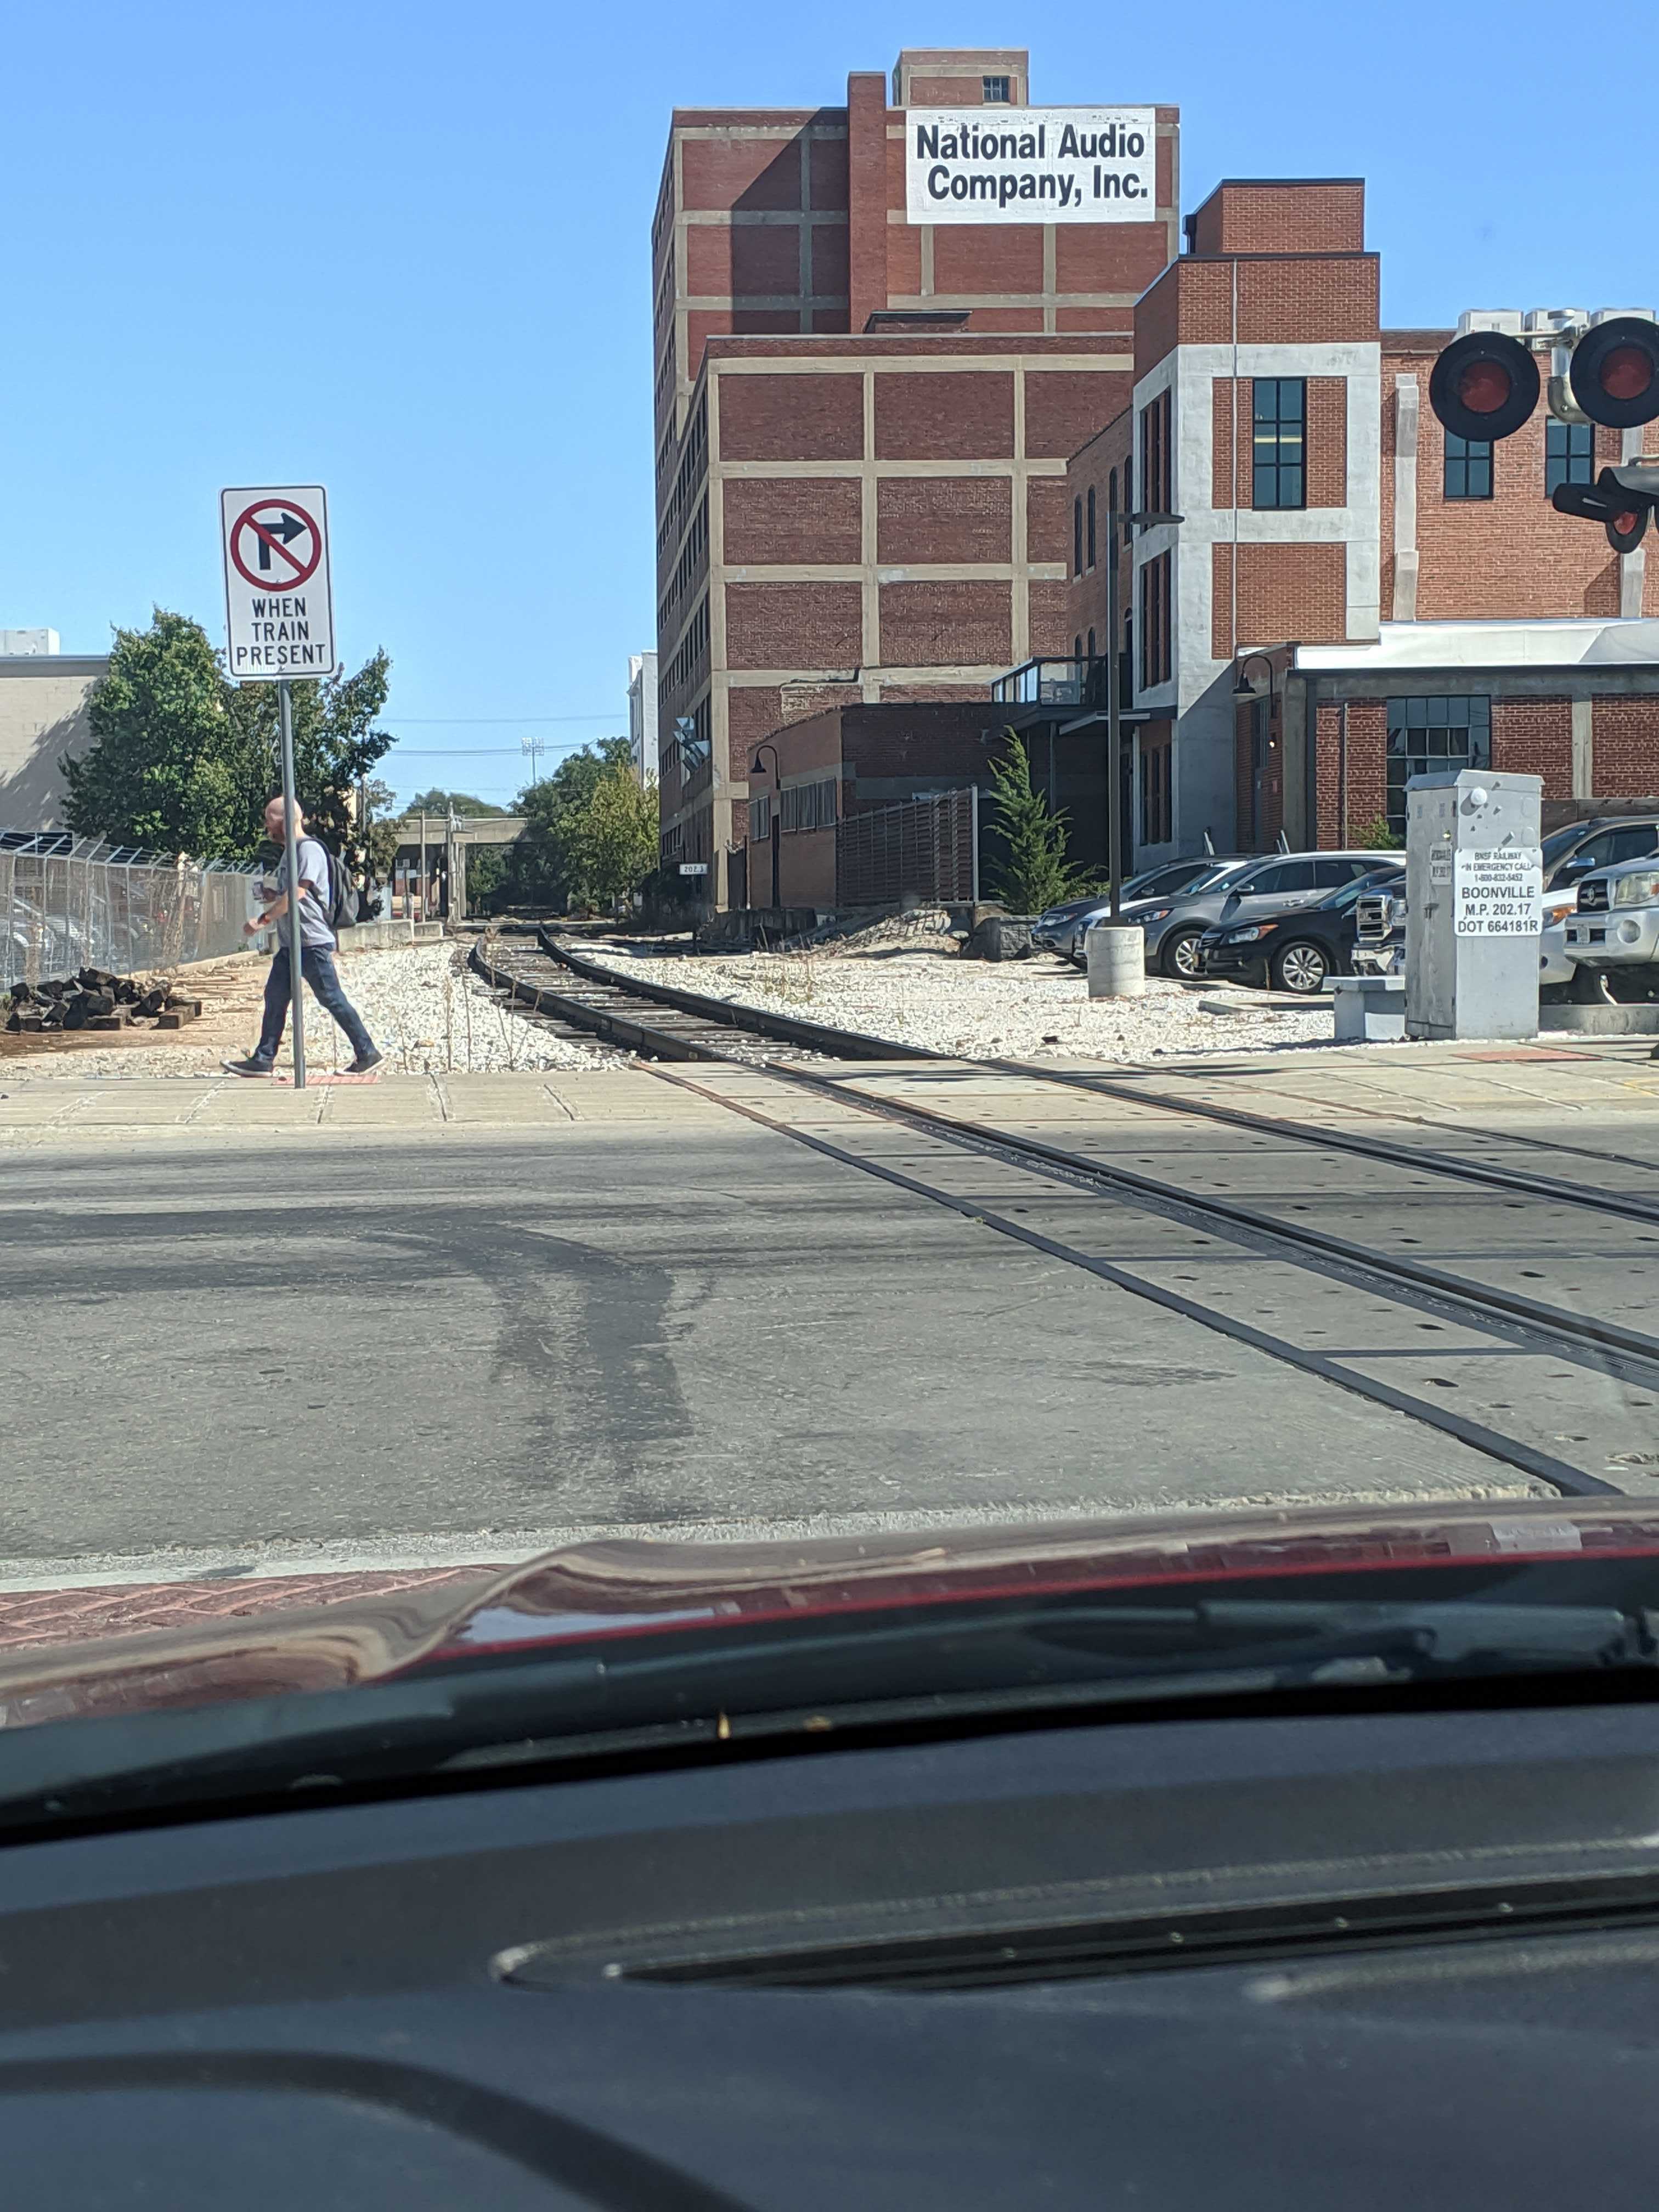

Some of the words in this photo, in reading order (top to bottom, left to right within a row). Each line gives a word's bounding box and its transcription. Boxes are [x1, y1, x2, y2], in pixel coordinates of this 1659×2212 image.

[917, 123, 1045, 159] National
[1058, 123, 1144, 159] Audio
[927, 165, 1082, 208] Company,
[1093, 165, 1148, 199] Inc.
[252, 597, 306, 618] WHEN
[251, 620, 309, 641] TRAIN
[236, 644, 326, 665] PRESENT
[1462, 886, 1534, 899] BOONVILLE
[1465, 904, 1489, 916] M.P.
[1492, 903, 1531, 916] 202.17
[1458, 920, 1484, 932] DOT
[1487, 920, 1538, 932] 664181R
